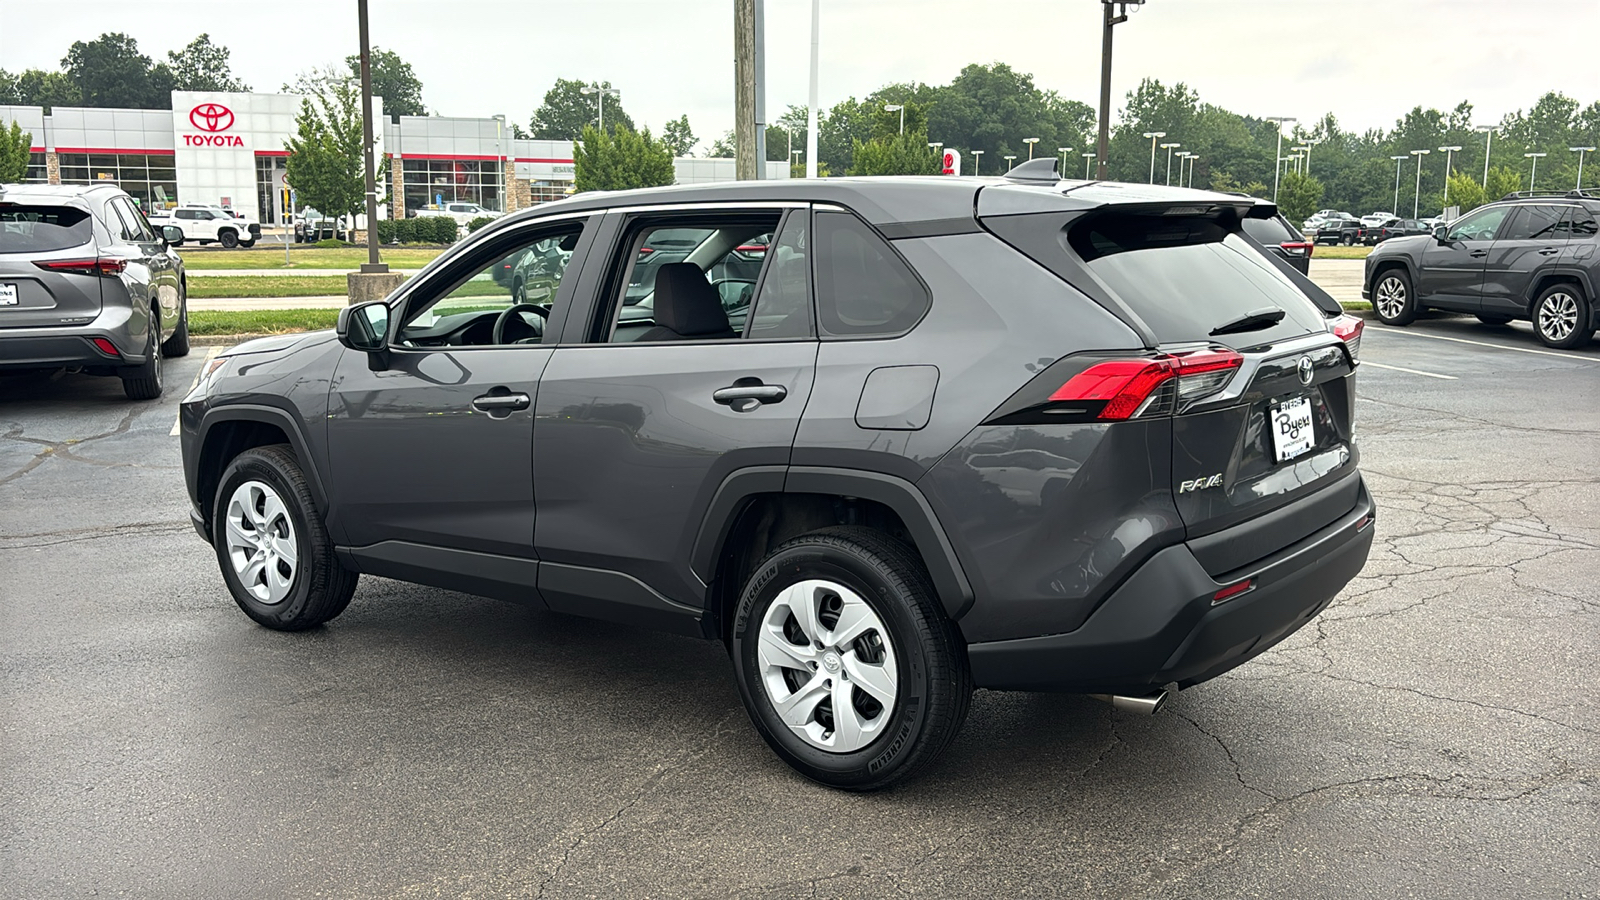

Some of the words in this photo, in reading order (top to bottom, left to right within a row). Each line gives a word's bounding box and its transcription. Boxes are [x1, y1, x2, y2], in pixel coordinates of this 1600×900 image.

[182, 134, 244, 147] TOYOTA
[1274, 413, 1310, 440] Byers
[1179, 472, 1223, 494] RAV4
[742, 565, 777, 615] MICHELIN
[870, 724, 910, 772] MICHELIN
